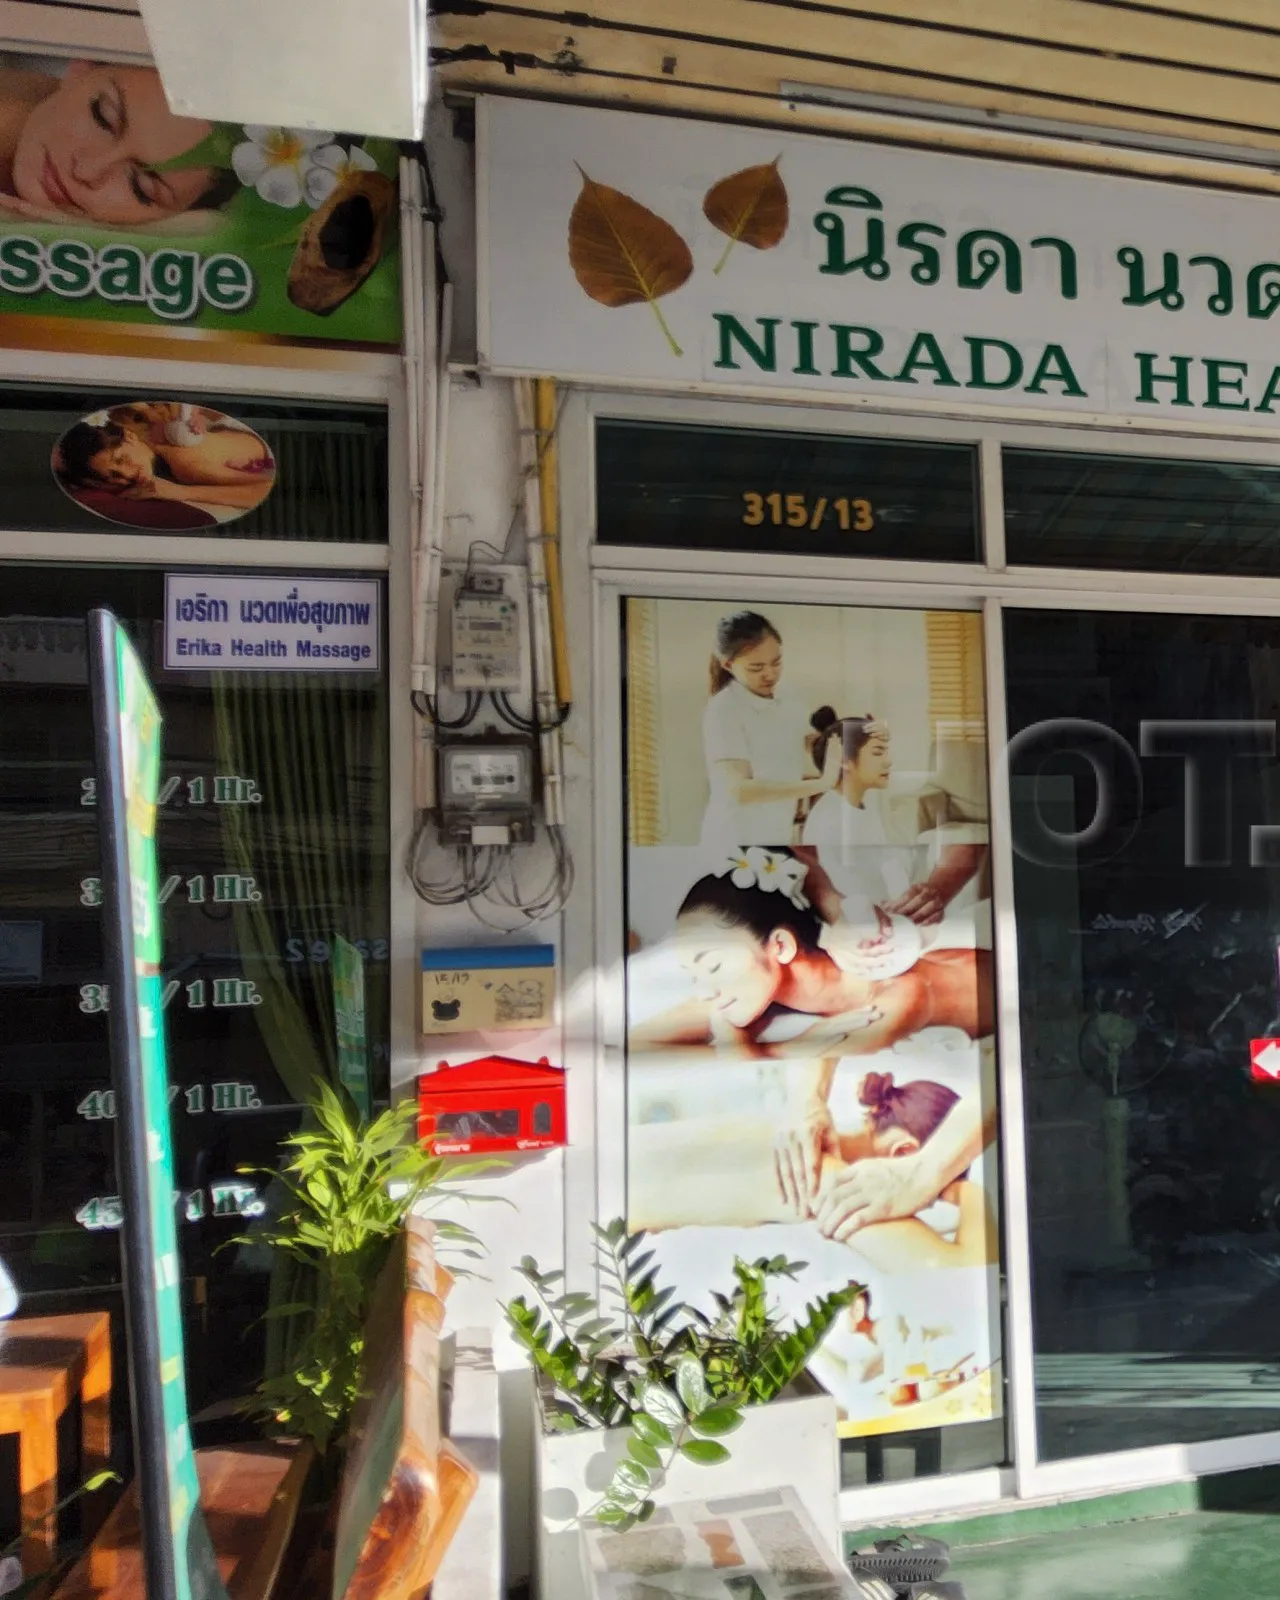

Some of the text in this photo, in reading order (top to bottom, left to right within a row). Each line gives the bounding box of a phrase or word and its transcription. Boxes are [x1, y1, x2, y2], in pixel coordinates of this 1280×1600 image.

[813, 186, 1077, 300] นิรดา
[712, 312, 1089, 397] NIRADA
[742, 490, 875, 531] 315/13
[176, 587, 370, 633] เอริกา นวดเพื่อสุขภาพ
[176, 638, 370, 661] Erika Health Massage
[213, 776, 262, 803] Hr.
[213, 874, 262, 902] Hr.
[213, 978, 262, 1007] Hr.
[212, 1083, 262, 1112] Hr.
